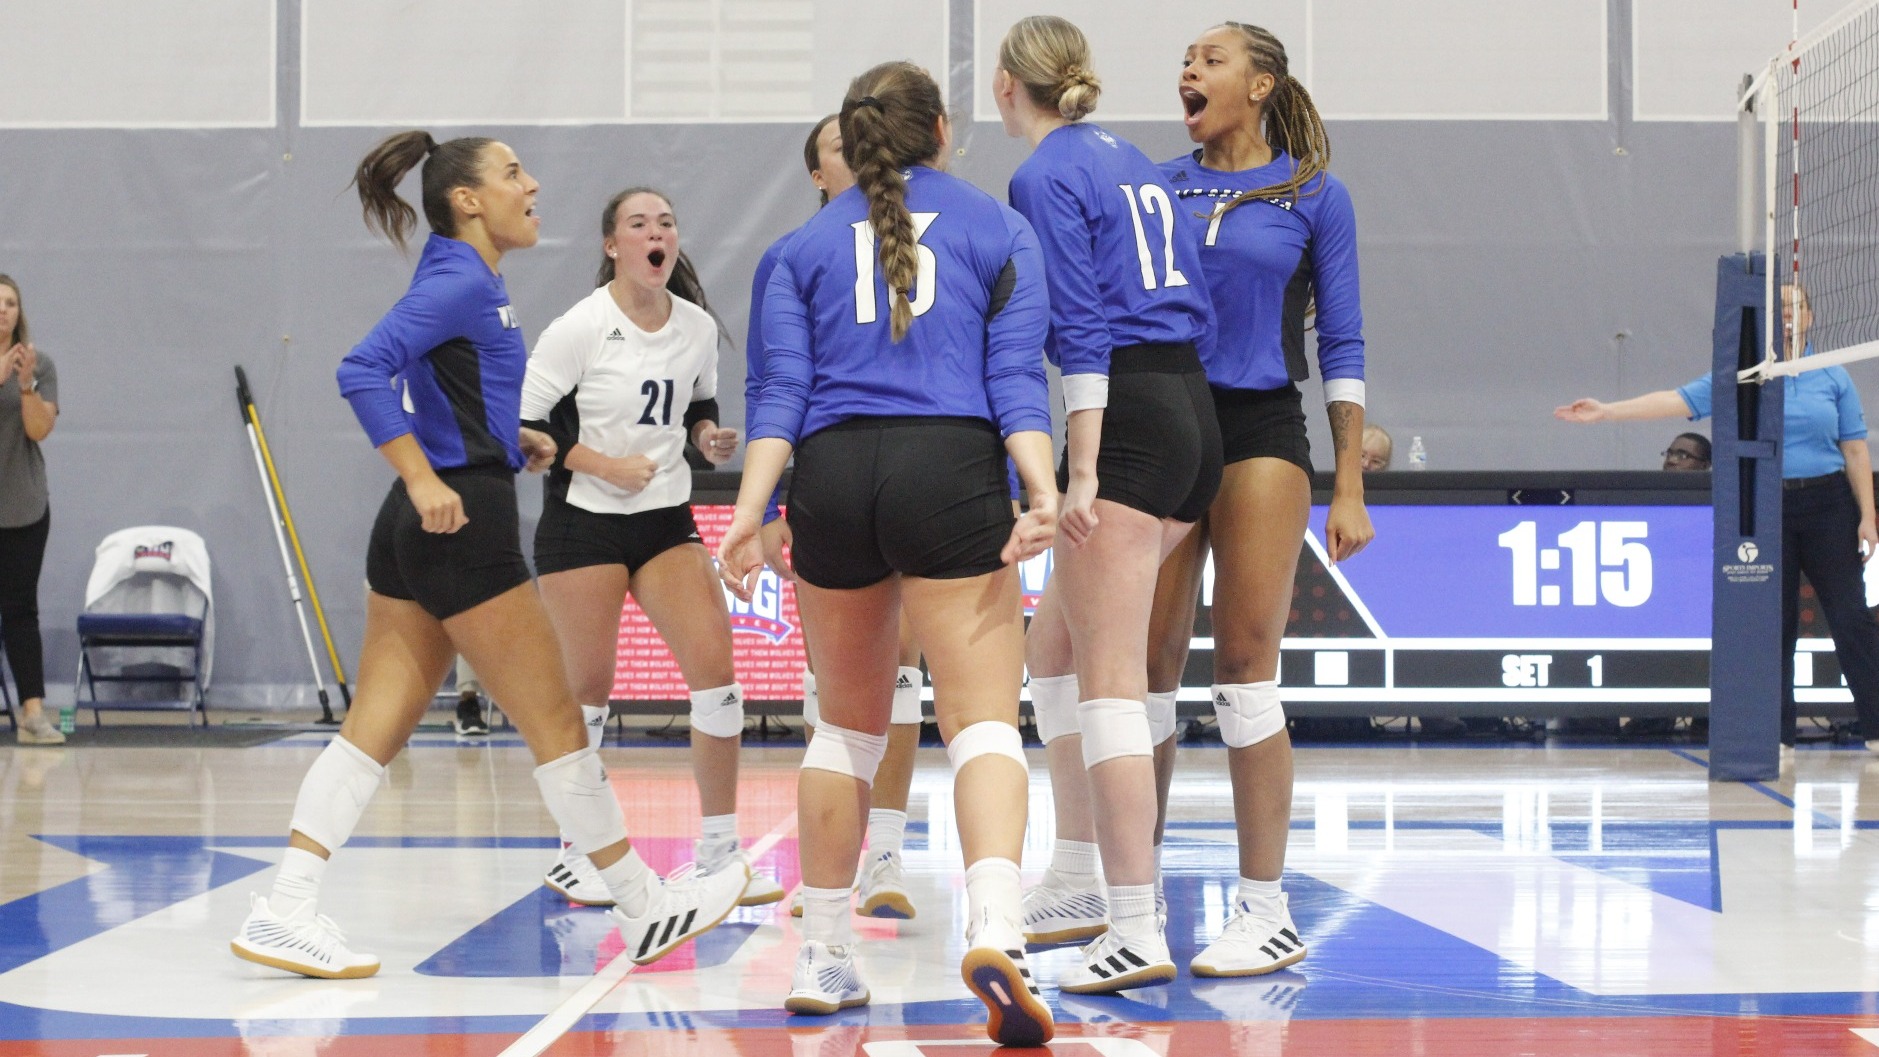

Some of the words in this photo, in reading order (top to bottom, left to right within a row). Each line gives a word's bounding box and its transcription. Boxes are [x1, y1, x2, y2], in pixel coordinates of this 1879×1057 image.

[1118, 183, 1189, 290] 12
[637, 379, 674, 426] 21
[1498, 520, 1653, 608] 1:15
[1501, 654, 1553, 687] SET
[1587, 655, 1603, 687] 1
